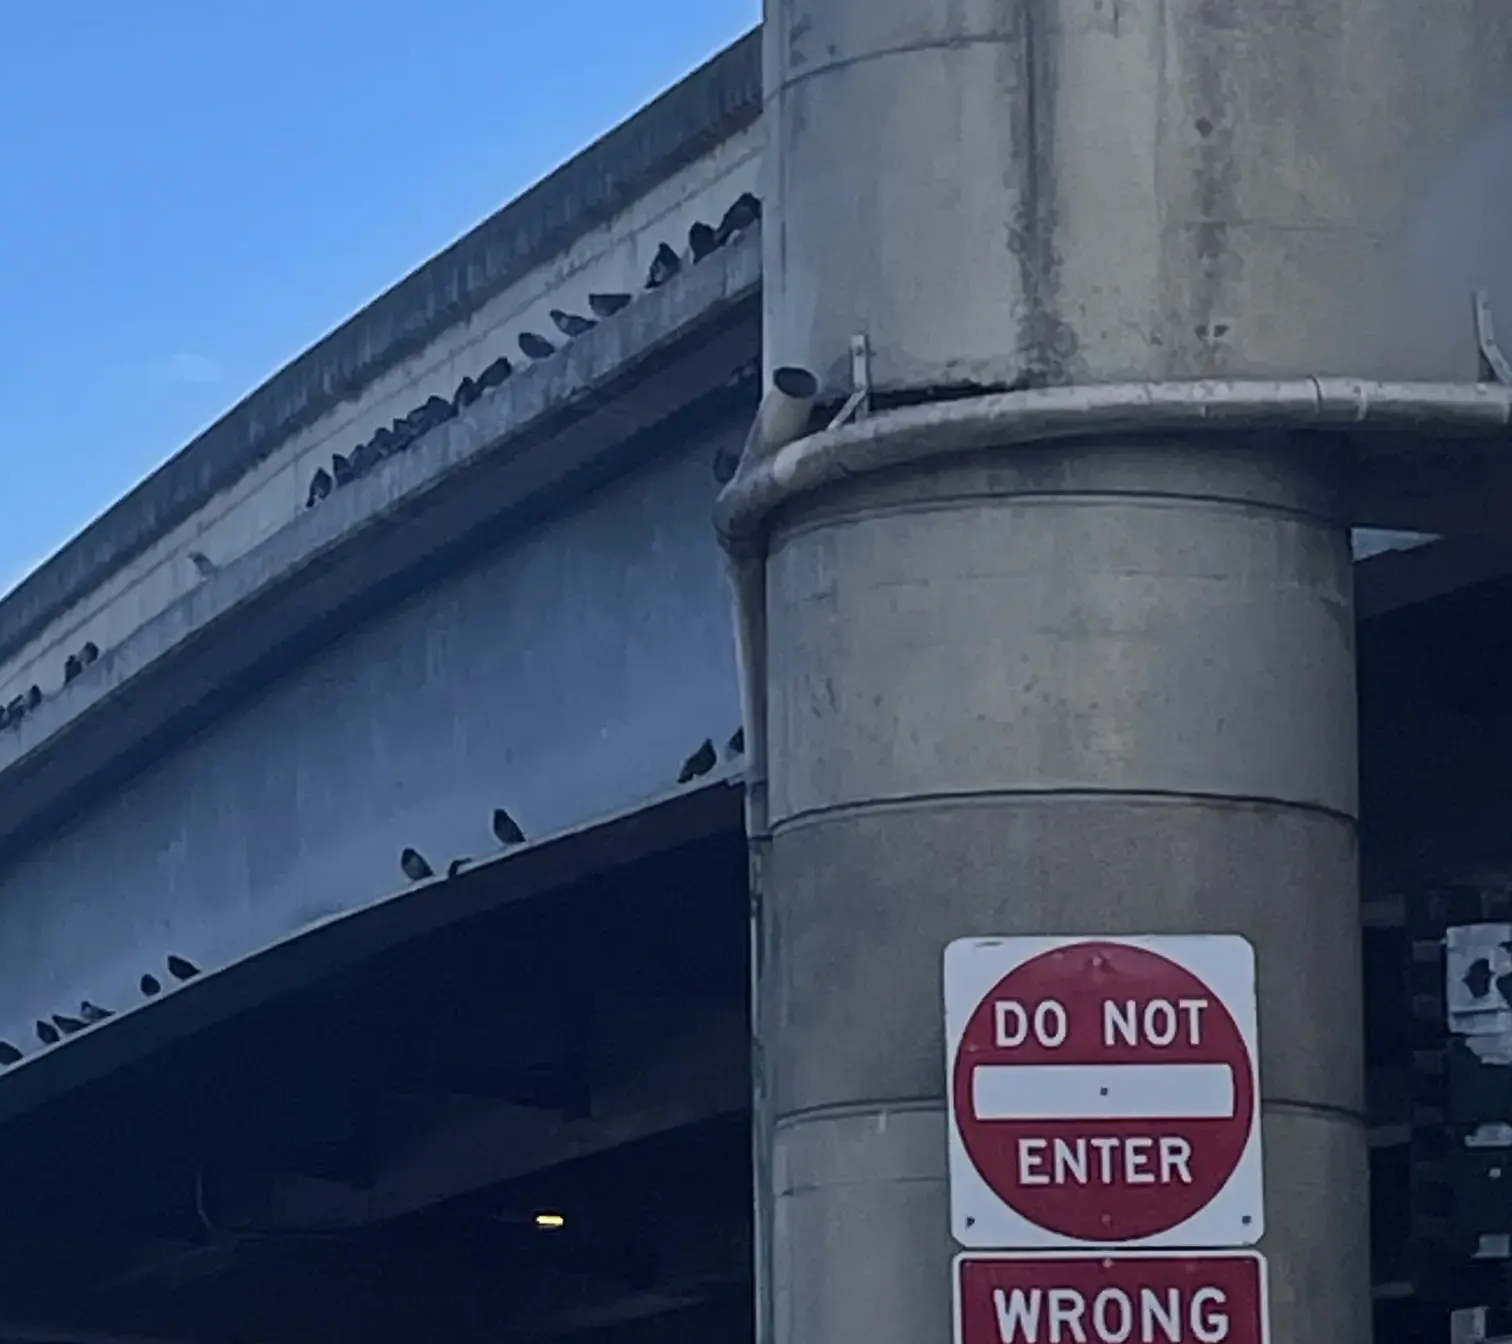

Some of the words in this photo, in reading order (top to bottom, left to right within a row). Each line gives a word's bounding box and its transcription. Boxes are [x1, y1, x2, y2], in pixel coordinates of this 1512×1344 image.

[993, 999, 1068, 1048] DO
[1103, 998, 1209, 1047] NOT
[1017, 1137, 1193, 1185] ENTER
[993, 1287, 1229, 1344] WRONG
